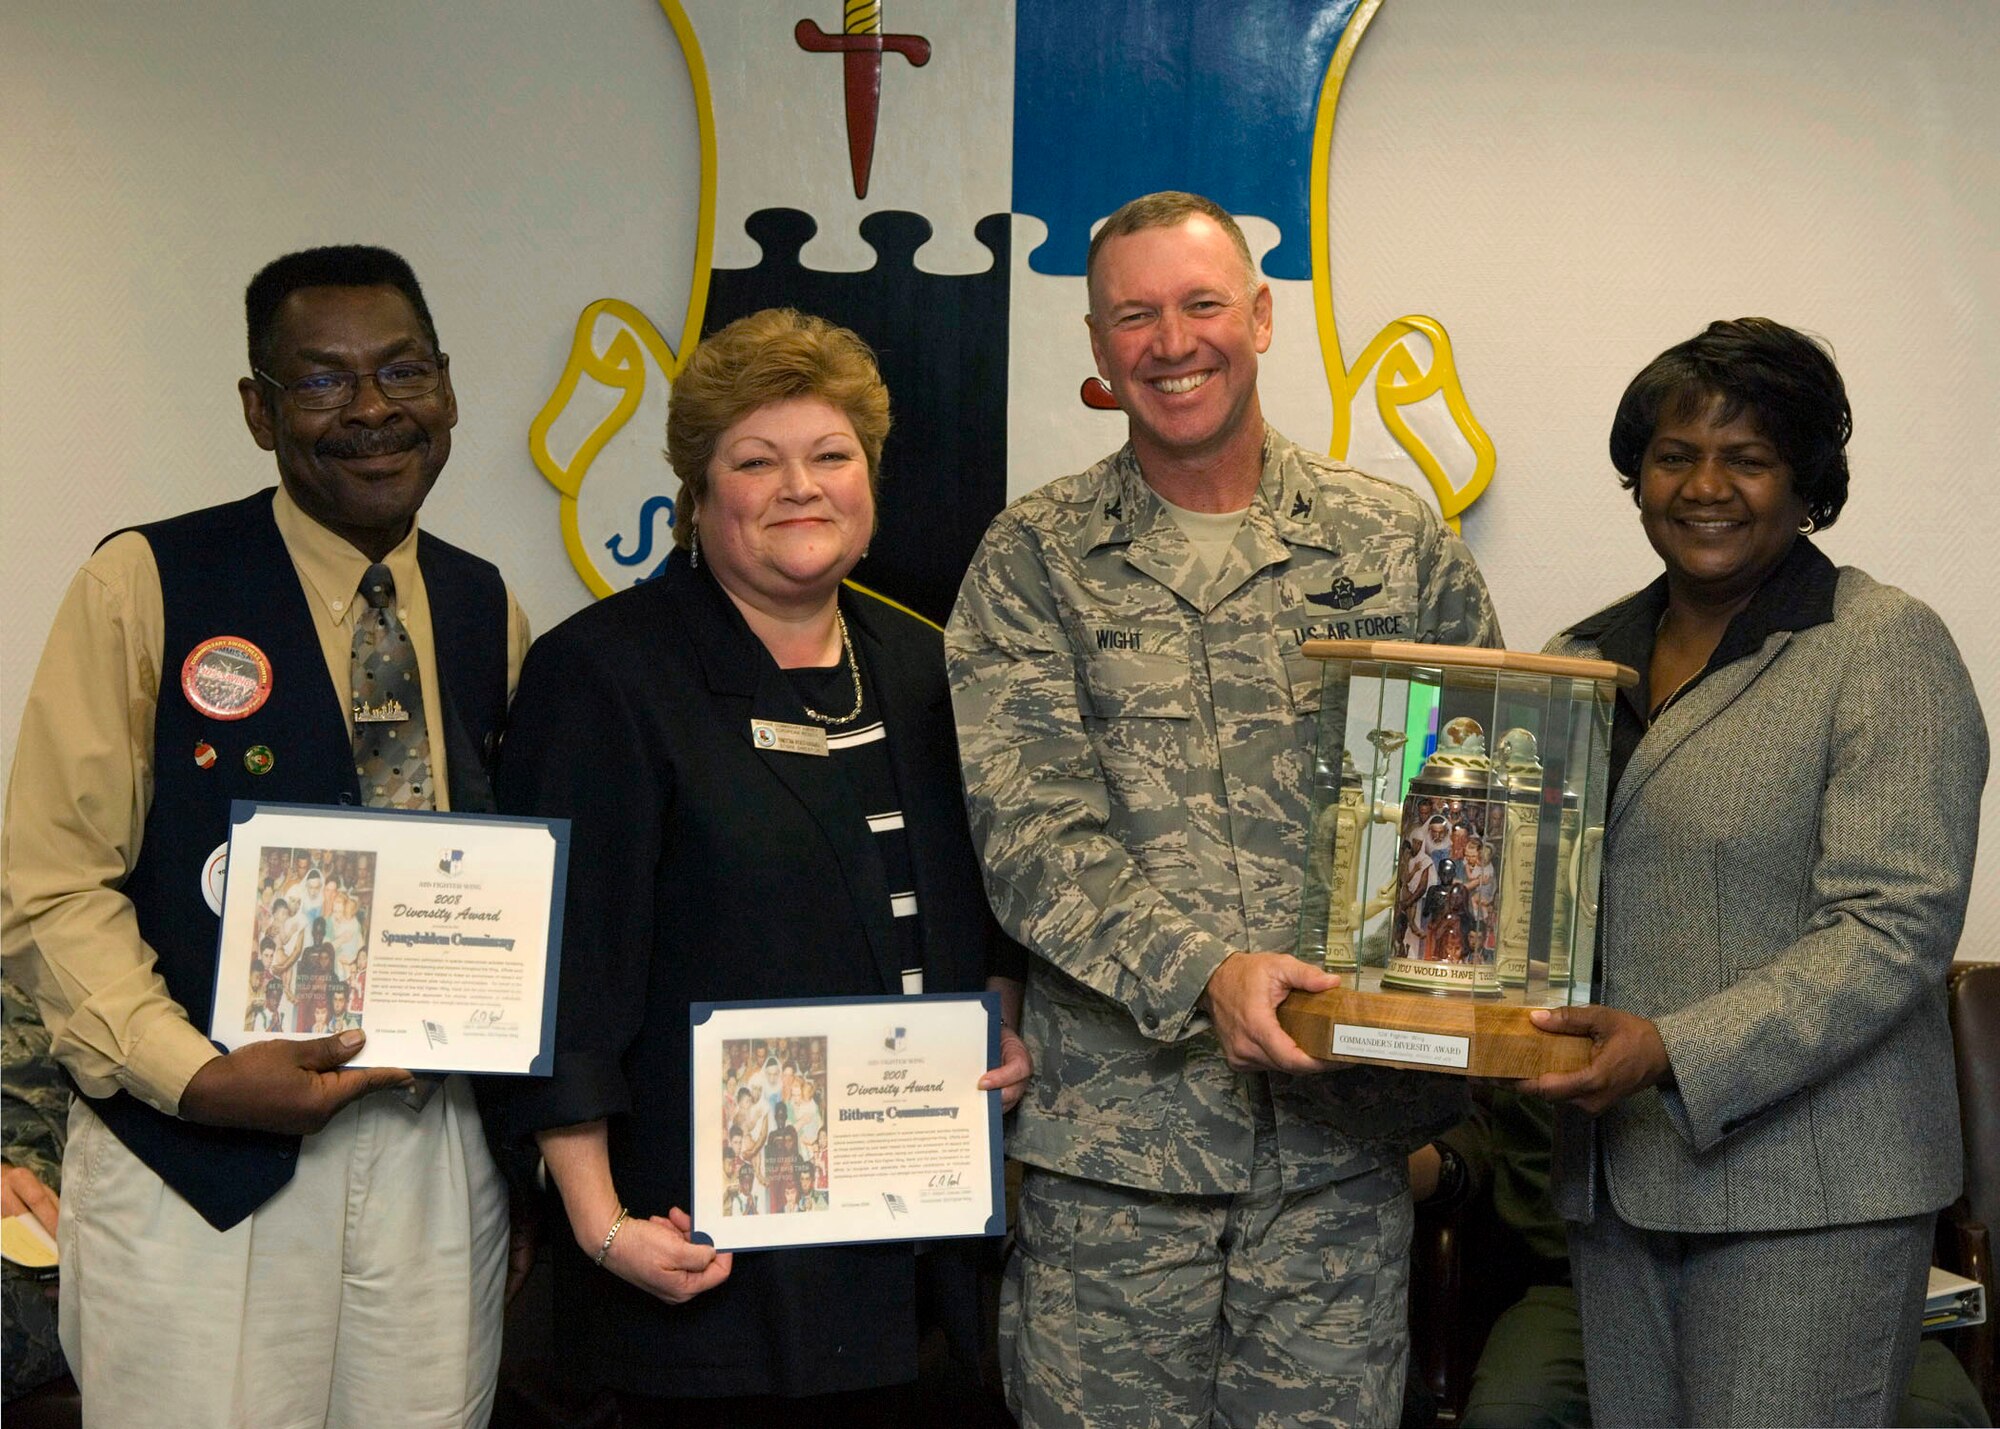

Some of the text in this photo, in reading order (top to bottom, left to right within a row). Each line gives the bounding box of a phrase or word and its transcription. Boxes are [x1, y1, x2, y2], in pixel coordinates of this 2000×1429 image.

[1327, 621, 1352, 640] AIR
[1355, 615, 1403, 638] FORCE
[1096, 629, 1143, 650] WIGHT
[191, 641, 227, 665] COMMISSARY
[434, 893, 462, 906] 2008
[393, 904, 502, 922] Diversity Award
[1397, 964, 1412, 974] YOU
[1414, 966, 1448, 978] WOULD
[1450, 970, 1474, 980] HAVE
[1339, 1034, 1393, 1048] COMMANDER'S
[1394, 1041, 1432, 1053] DIVERSITY
[1433, 1044, 1462, 1056] AWARD
[883, 1070, 909, 1081] 2008
[846, 1080, 945, 1097] Diversity Award
[839, 1107, 885, 1123] Bitburg
